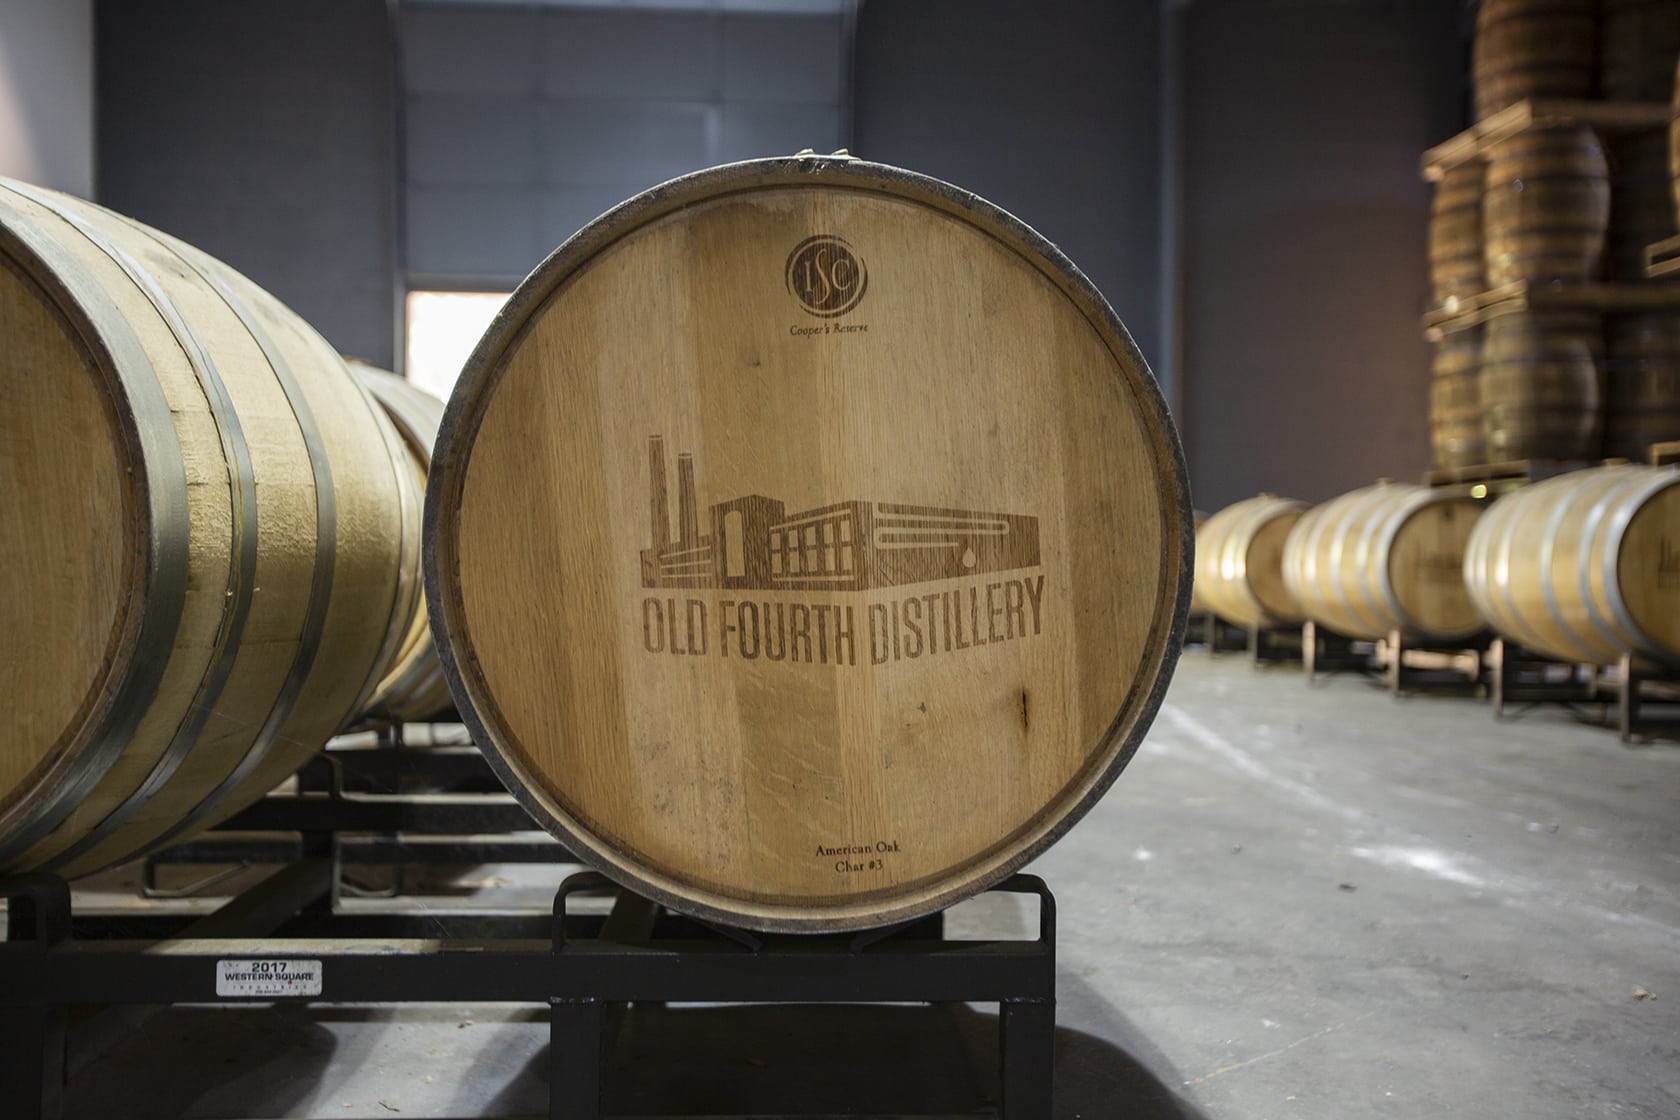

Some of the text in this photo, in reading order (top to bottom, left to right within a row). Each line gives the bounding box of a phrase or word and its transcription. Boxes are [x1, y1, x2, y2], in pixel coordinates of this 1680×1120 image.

[804, 248, 851, 305] ISC
[790, 322, 868, 339] Cooper's Reserve
[642, 575, 1045, 666] OLD FOURTH DISTILLERY
[815, 840, 901, 857] American Oak
[835, 859, 883, 873] Char #3
[251, 962, 287, 973] 2017
[224, 972, 314, 981] WESTERN SQUARE
